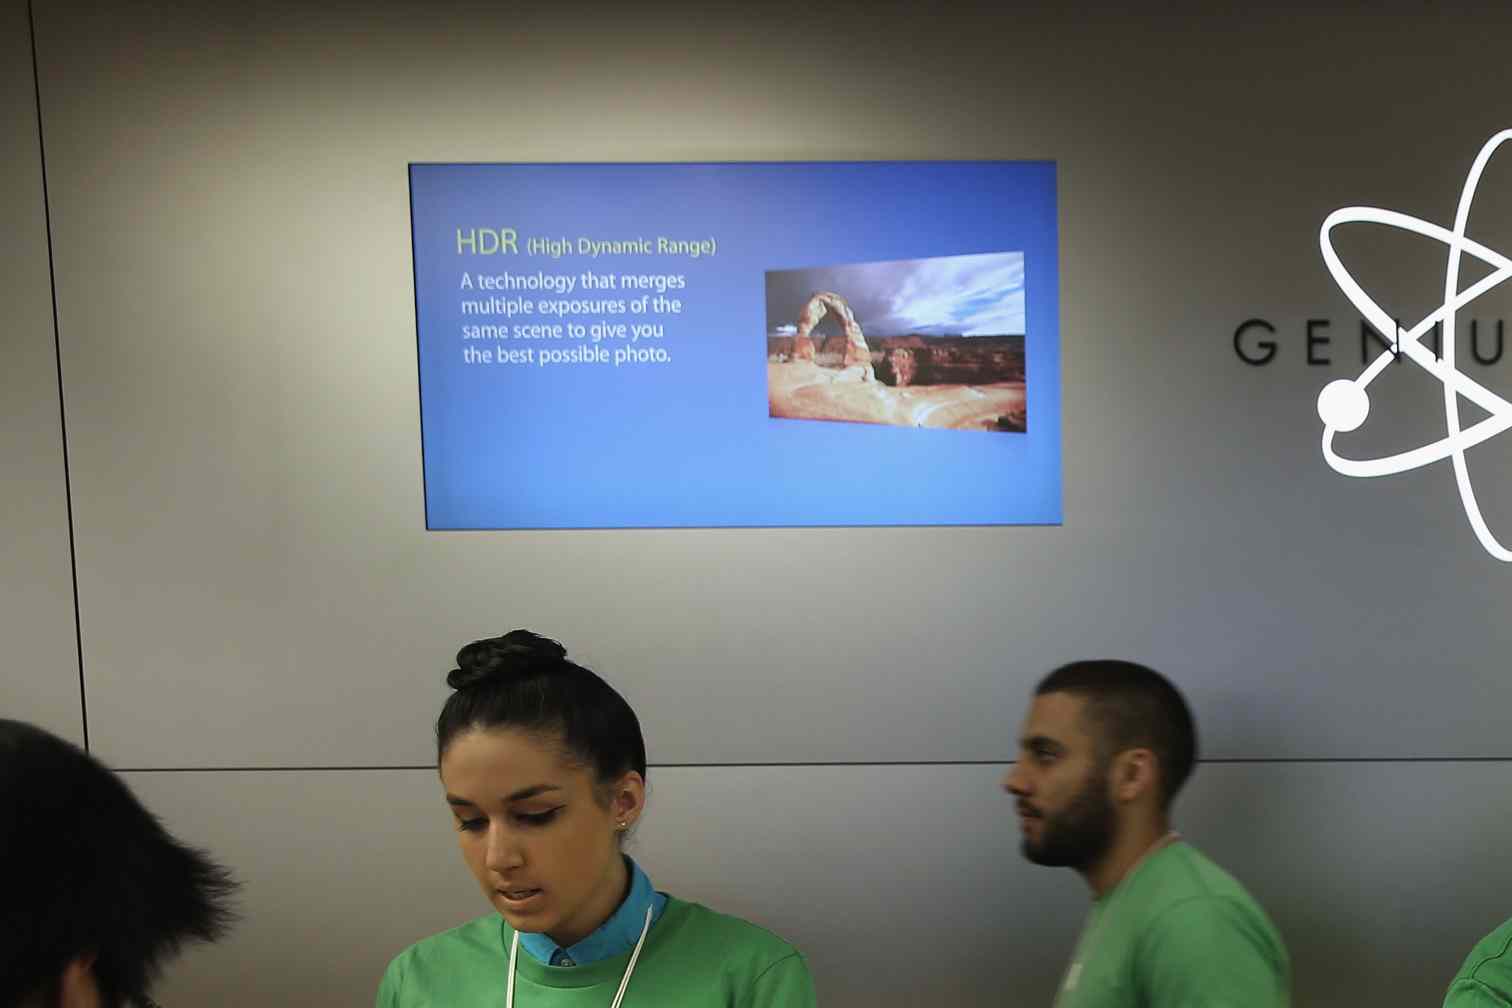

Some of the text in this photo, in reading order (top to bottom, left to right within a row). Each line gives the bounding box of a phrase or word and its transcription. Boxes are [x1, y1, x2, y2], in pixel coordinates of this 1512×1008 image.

[456, 227, 717, 259] HDR (High Dynamic Range)
[460, 270, 686, 294] A technology that merges
[461, 295, 682, 318] multiple exposures of the
[462, 320, 664, 342] same scene to give you
[464, 343, 672, 368] the best possible photo.
